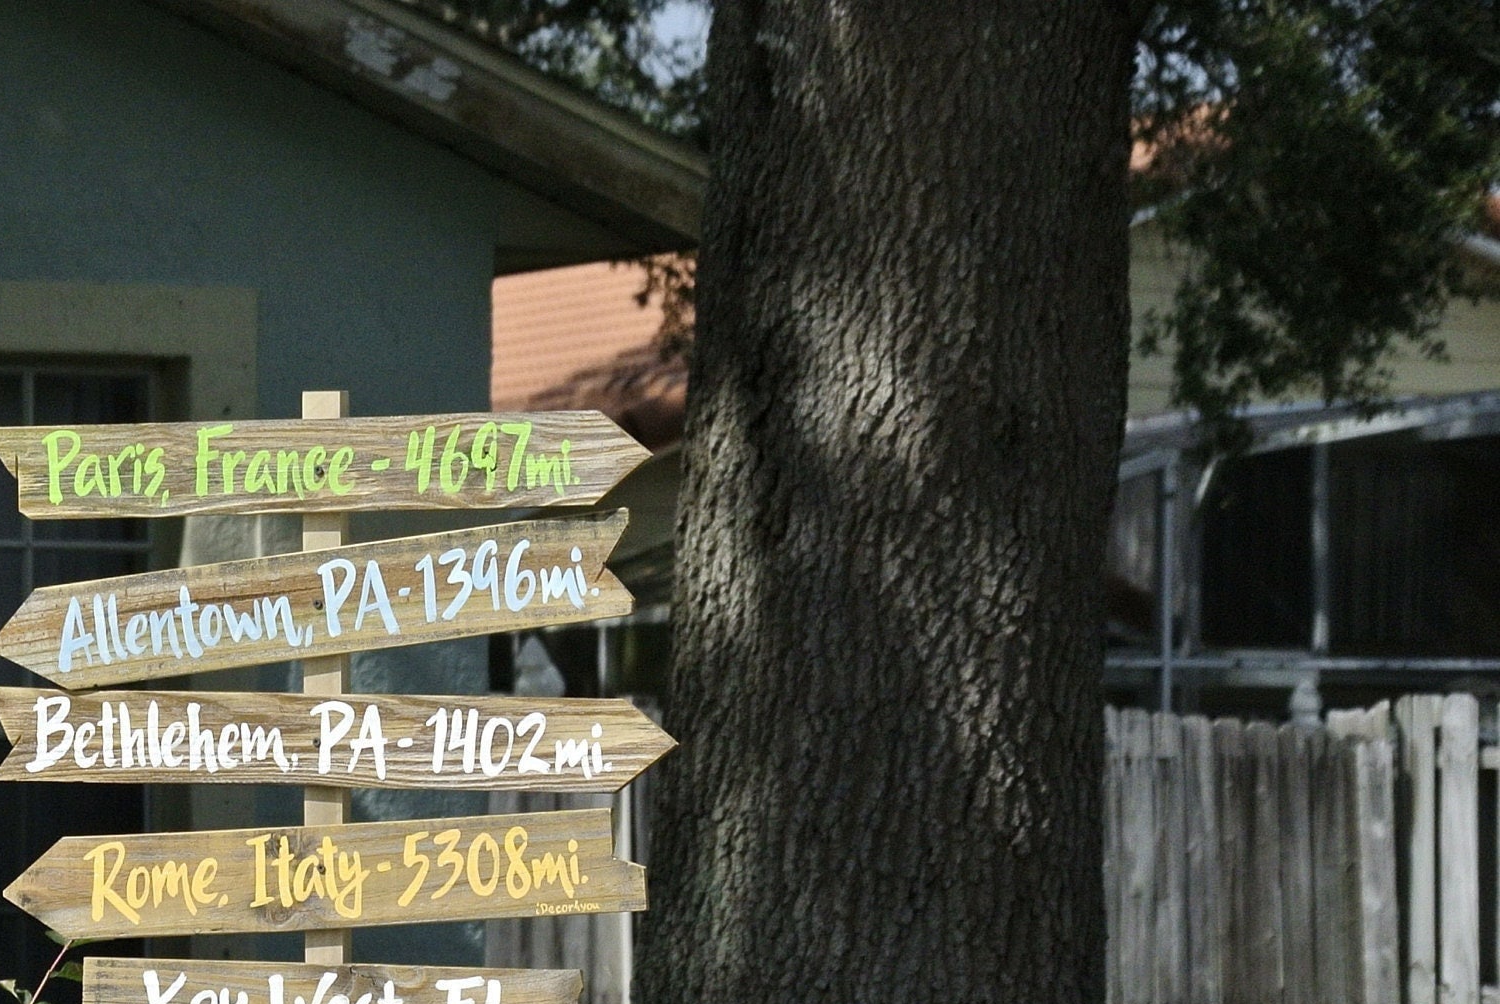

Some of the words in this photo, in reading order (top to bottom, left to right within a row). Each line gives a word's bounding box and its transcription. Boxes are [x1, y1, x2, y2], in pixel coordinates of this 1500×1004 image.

[42, 430, 172, 509] Paris,
[196, 424, 357, 500] France
[405, 421, 581, 496] 4697mi.
[58, 585, 313, 673] Allentown,
[310, 700, 388, 780] PA
[426, 706, 613, 780] 1402mi.
[397, 826, 590, 907] 5308mi.
